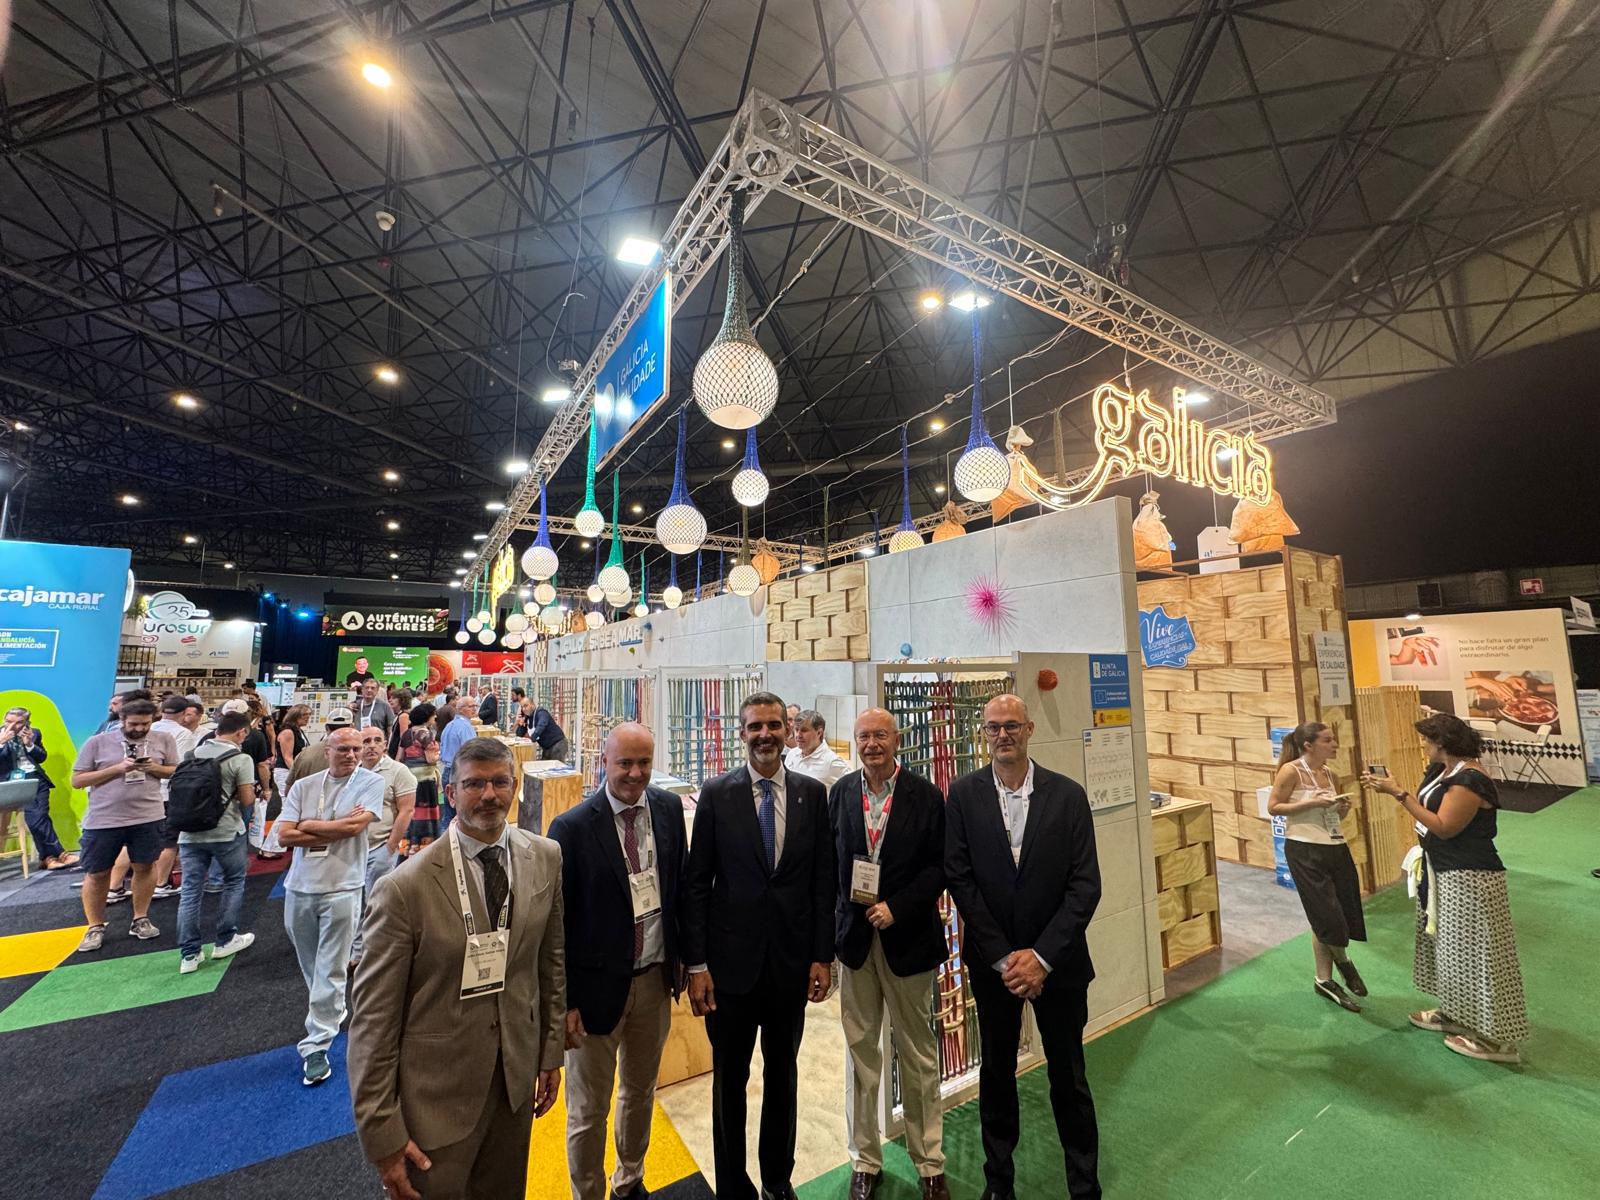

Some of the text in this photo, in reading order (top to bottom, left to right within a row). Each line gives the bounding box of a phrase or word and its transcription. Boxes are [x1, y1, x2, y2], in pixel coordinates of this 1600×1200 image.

[620, 338, 649, 385] GALICIA
[1019, 383, 1272, 510] galicia
[0, 585, 105, 607] cajamar
[167, 605, 190, 618] 25
[366, 612, 435, 624] AUTÉNTICA
[143, 623, 209, 635] urosur
[366, 622, 435, 632] CONGRESS
[1143, 613, 1174, 644] Vive
[1532, 636, 1549, 644] plan
